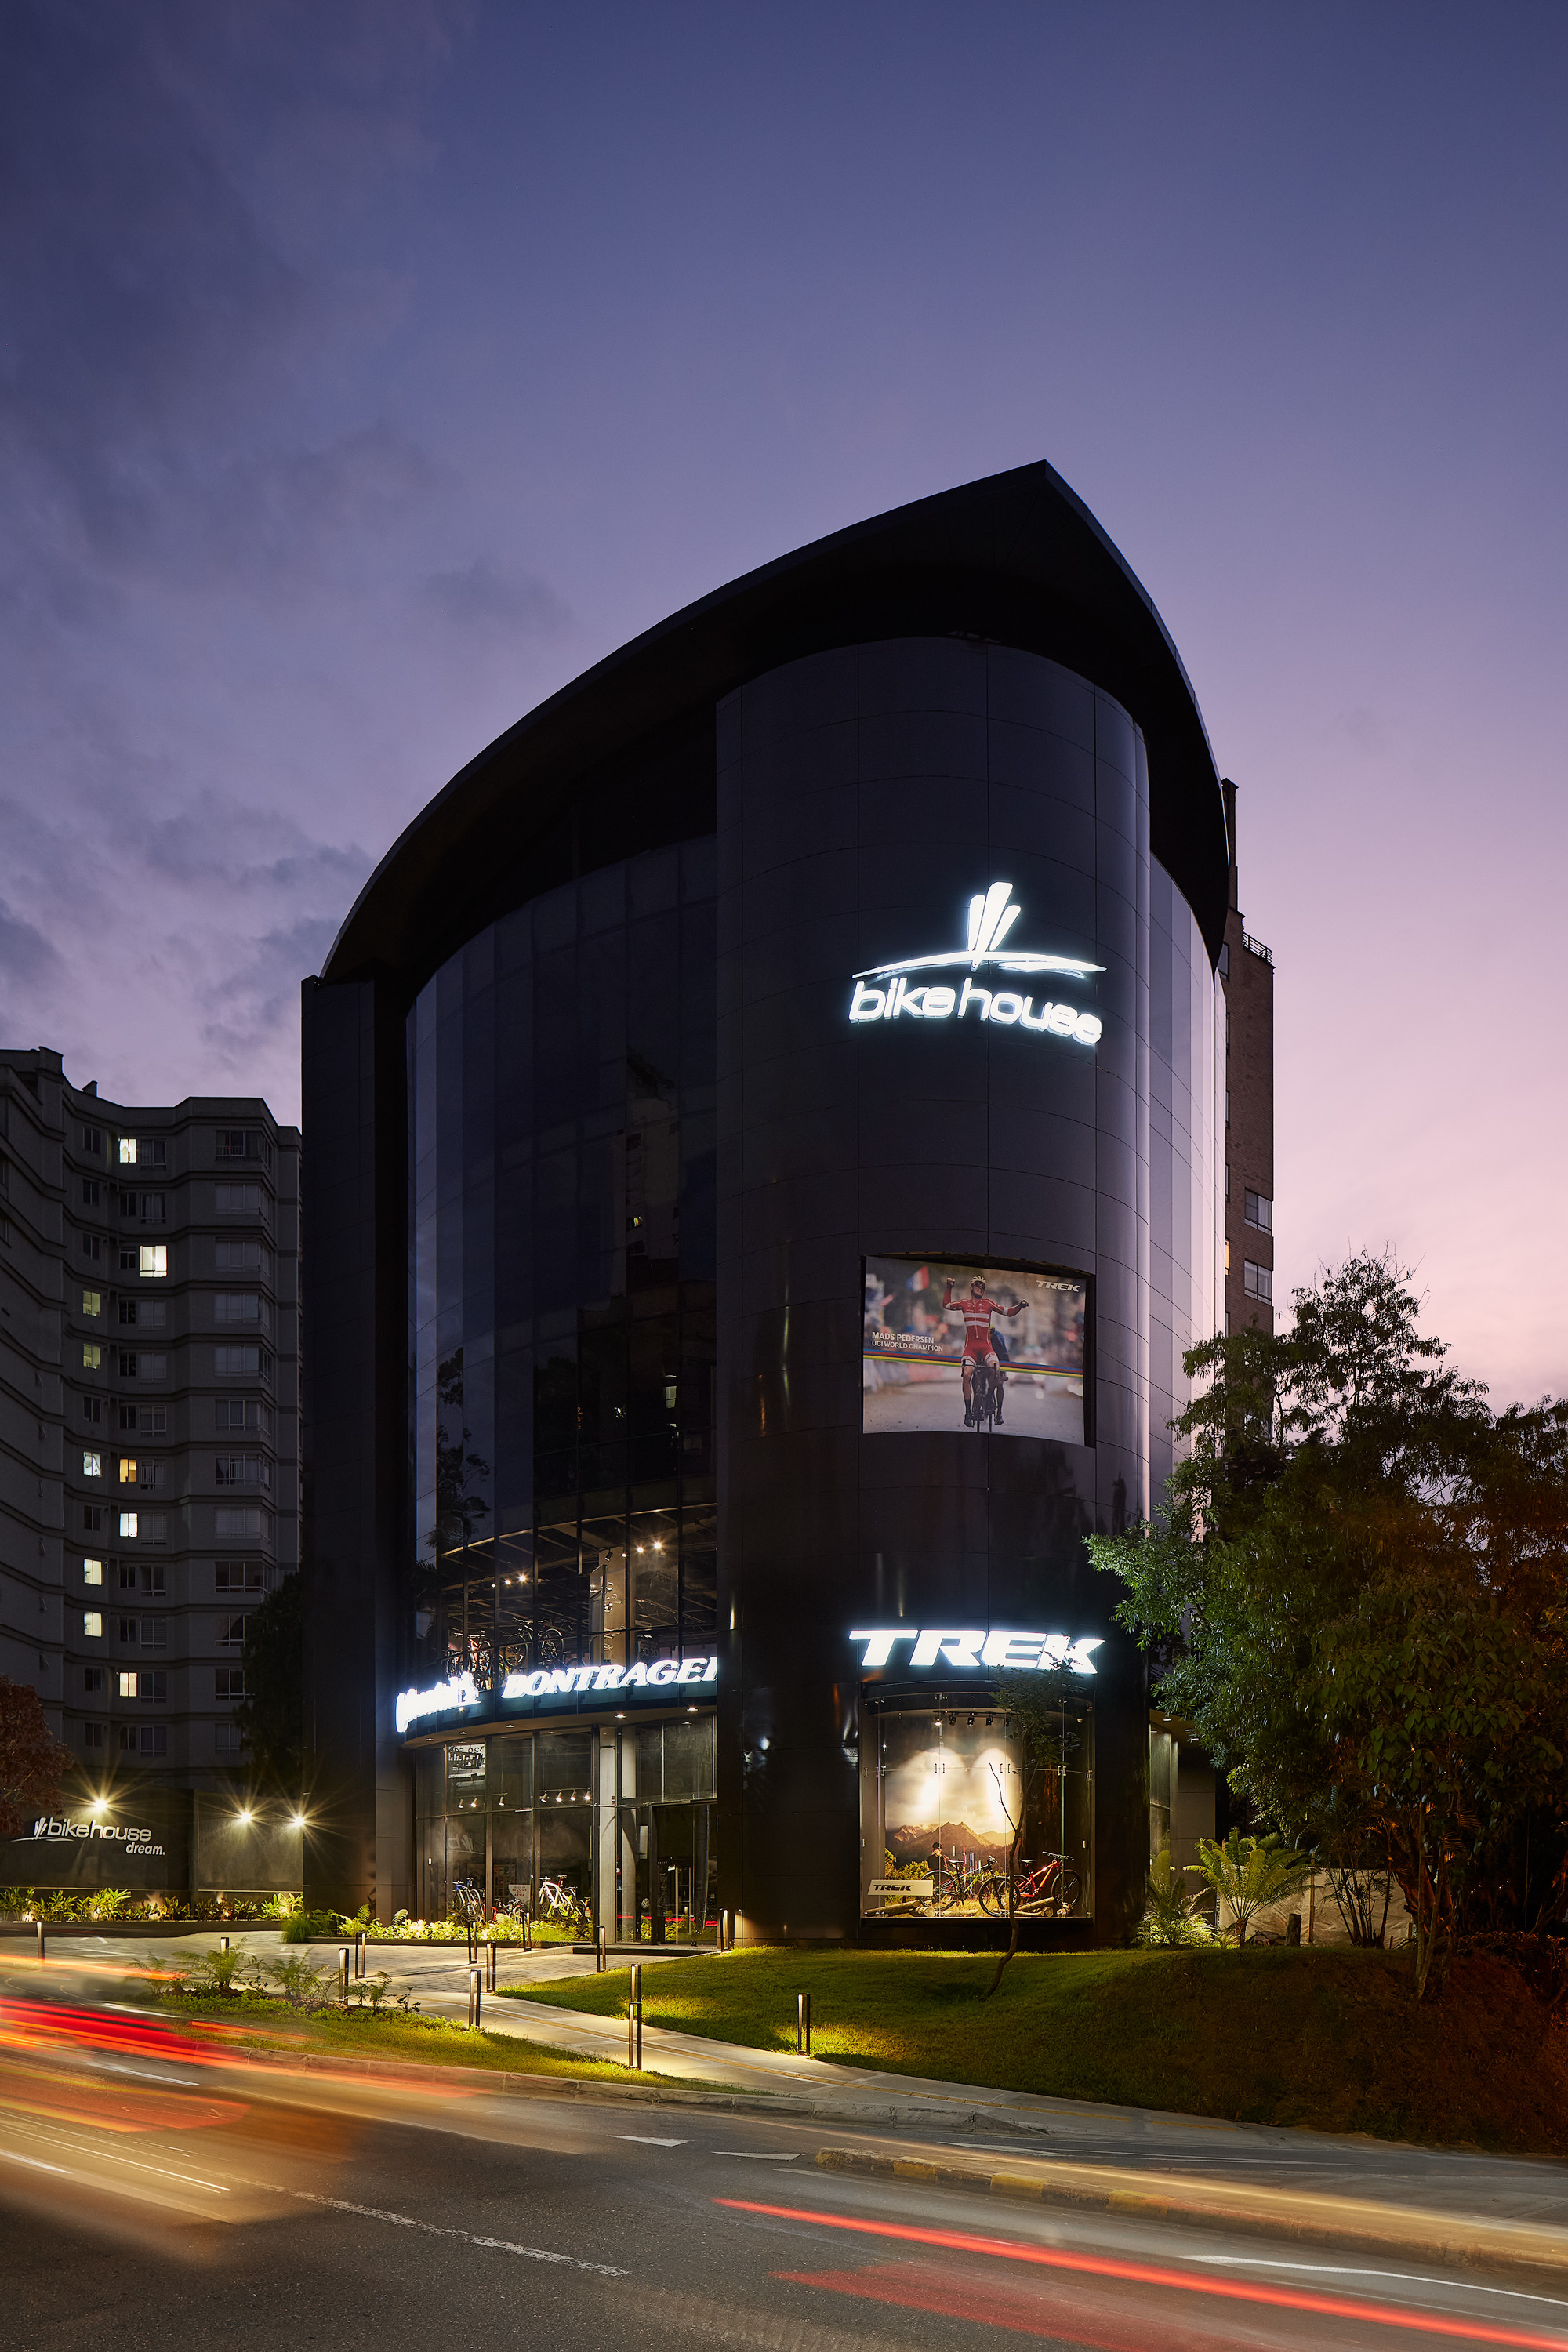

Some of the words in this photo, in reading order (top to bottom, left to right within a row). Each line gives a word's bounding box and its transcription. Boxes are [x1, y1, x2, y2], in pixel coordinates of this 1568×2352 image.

[1036, 1280, 1080, 1292] TREK
[872, 1332, 895, 1341] MADS
[897, 1334, 934, 1344] PEDERSEN
[909, 1343, 943, 1352] CHAMPION
[849, 1629, 1105, 1674] TREK
[47, 1817, 151, 1842] bikehouse
[125, 1842, 166, 1856] dream.
